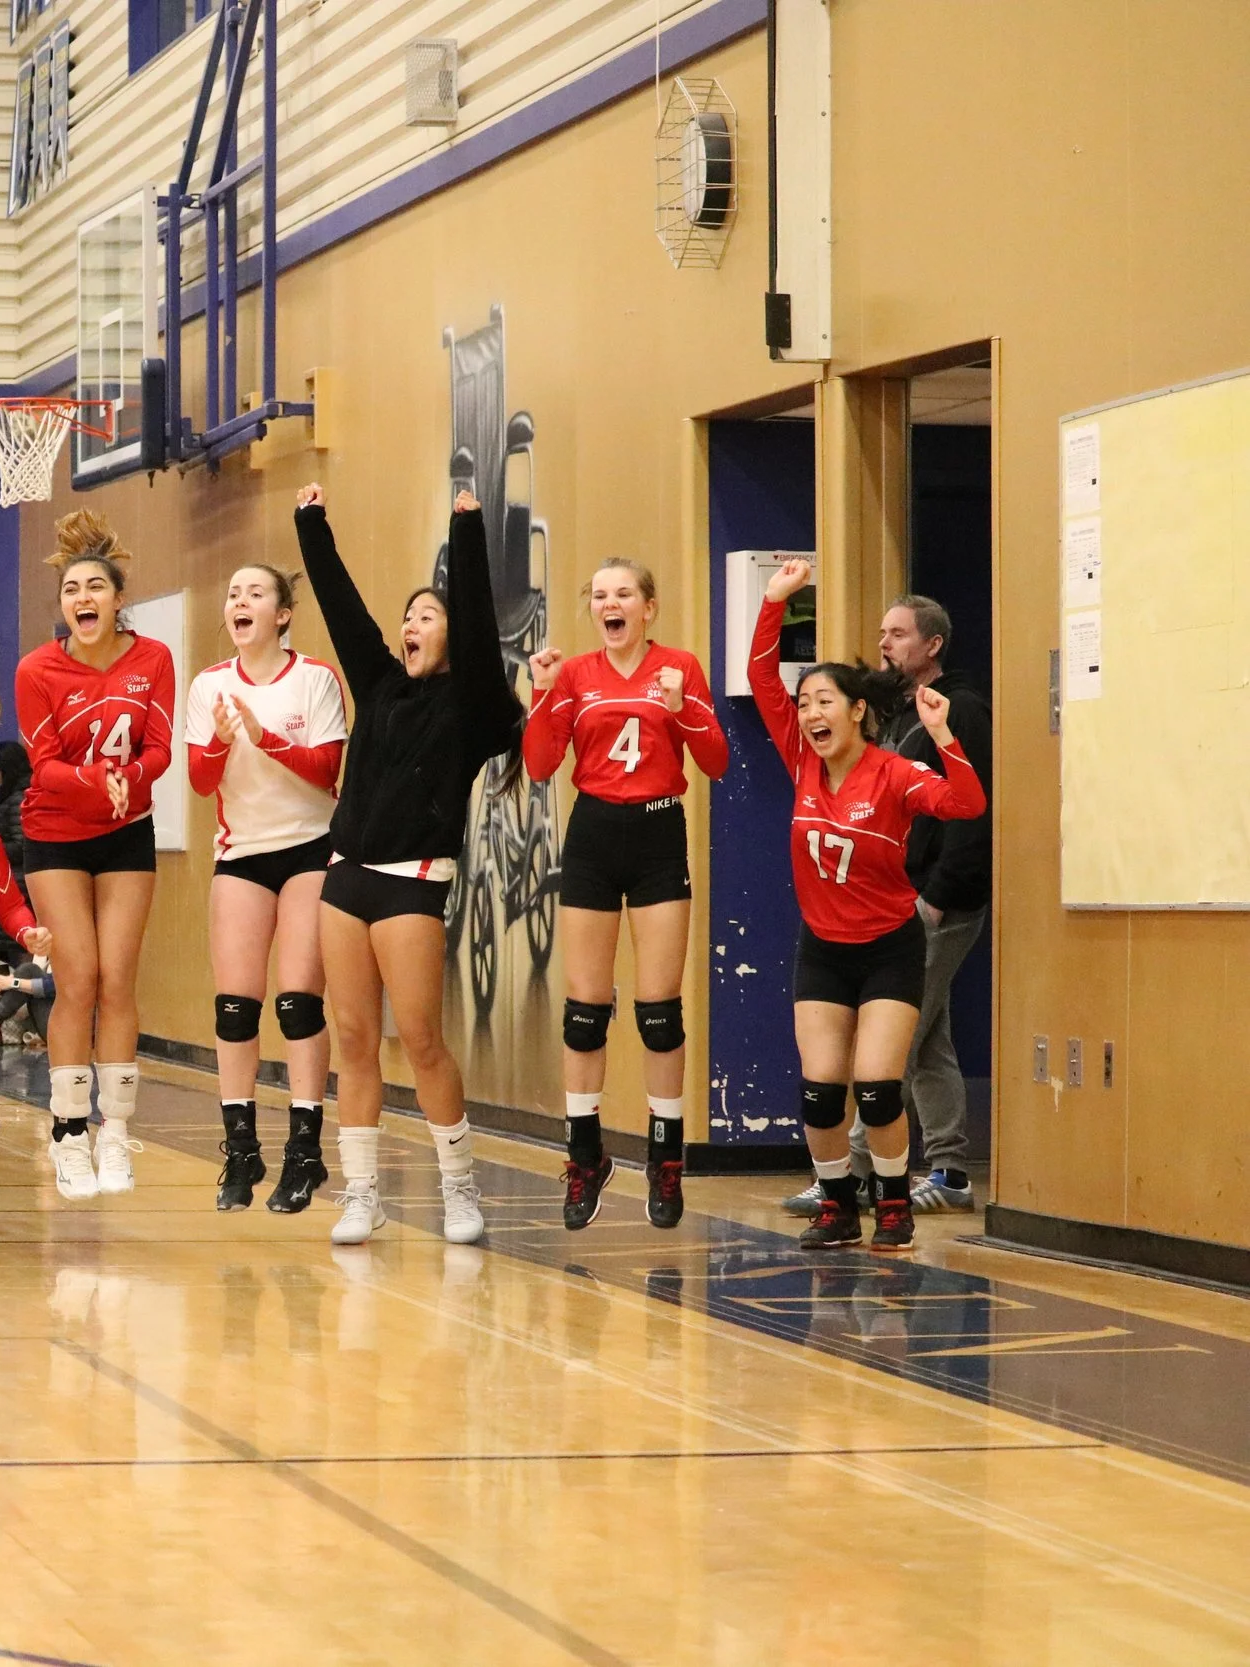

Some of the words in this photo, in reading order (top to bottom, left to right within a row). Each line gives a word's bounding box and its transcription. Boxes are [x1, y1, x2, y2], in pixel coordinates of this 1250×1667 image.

[127, 683, 150, 694] Stars
[286, 721, 305, 731] Stars
[83, 713, 132, 767] 14
[608, 717, 641, 773] 4
[646, 798, 670, 812] NIKE
[850, 808, 875, 822] Stars
[806, 830, 855, 884] 17
